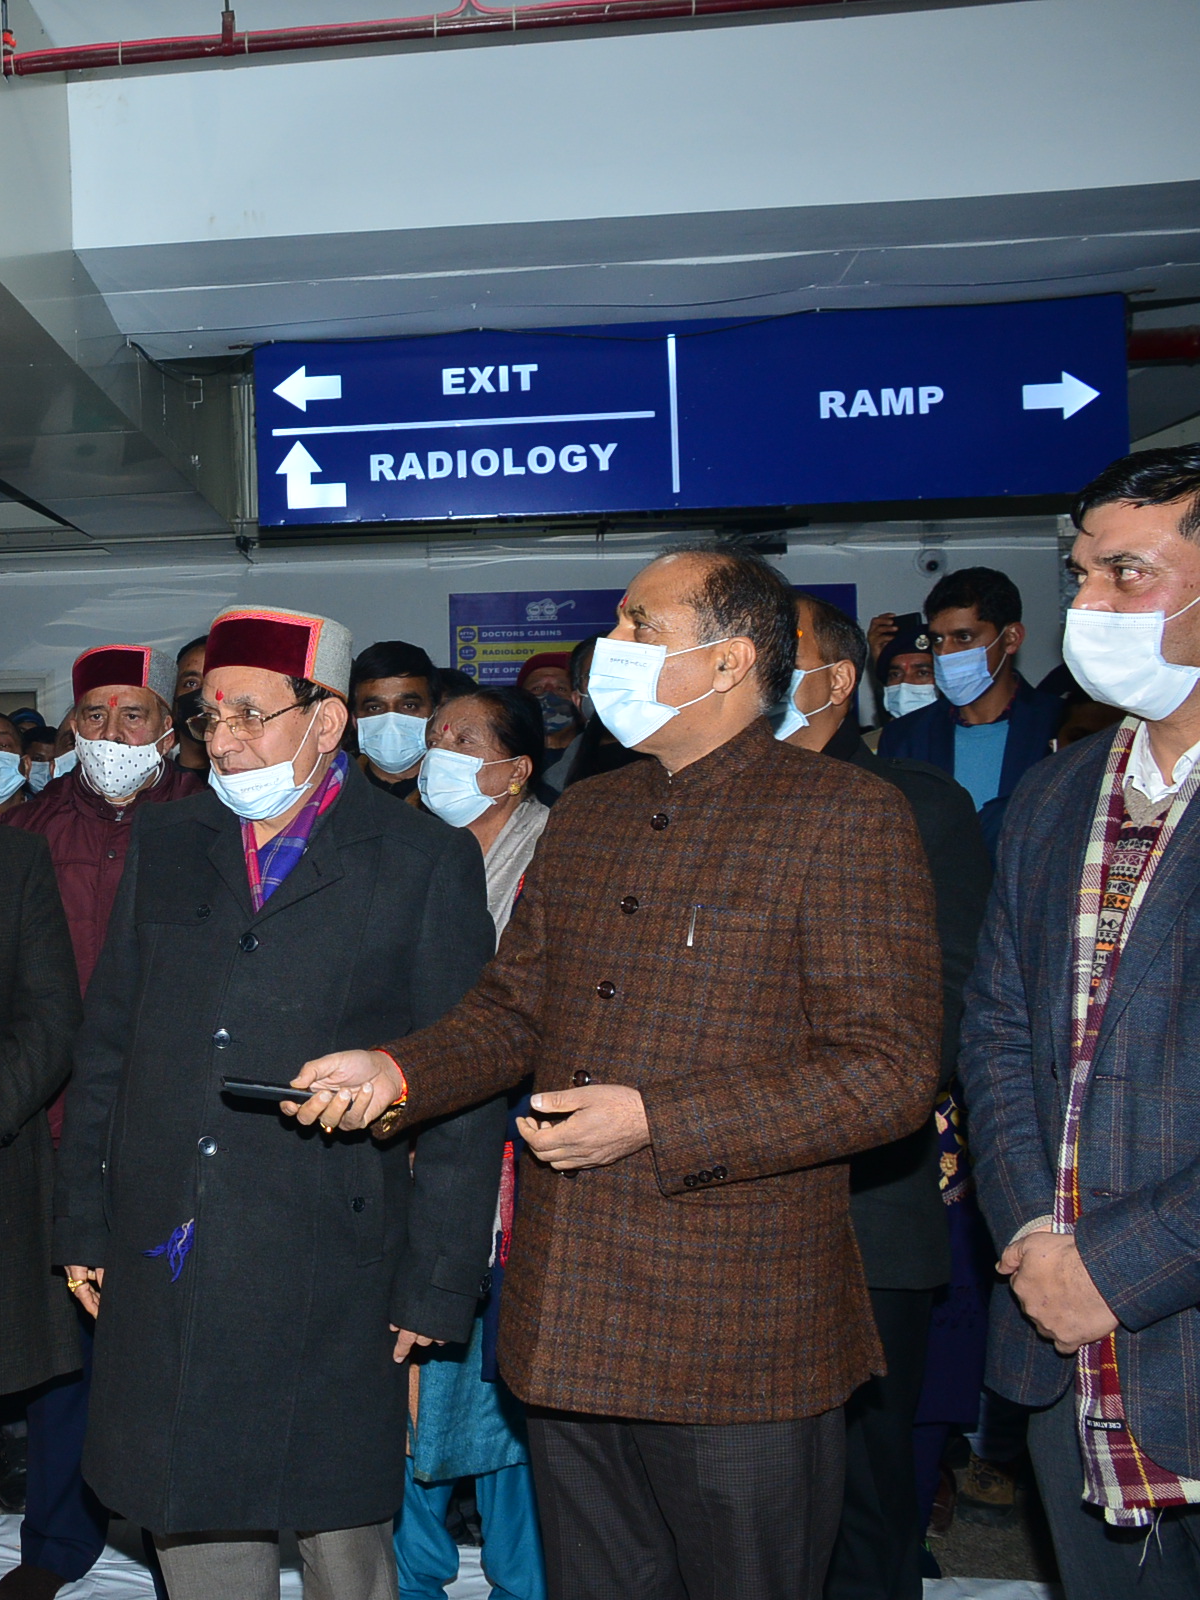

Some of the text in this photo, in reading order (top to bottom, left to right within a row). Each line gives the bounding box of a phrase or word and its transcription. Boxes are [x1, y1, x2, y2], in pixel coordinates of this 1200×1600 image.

[442, 363, 538, 395] EXIT
[819, 385, 944, 419] RAMP
[369, 442, 618, 482] RADIOLOGY
[481, 630, 525, 638] DOCTORS
[527, 629, 562, 637] CABINS
[482, 648, 536, 656] RADIOLOGY
